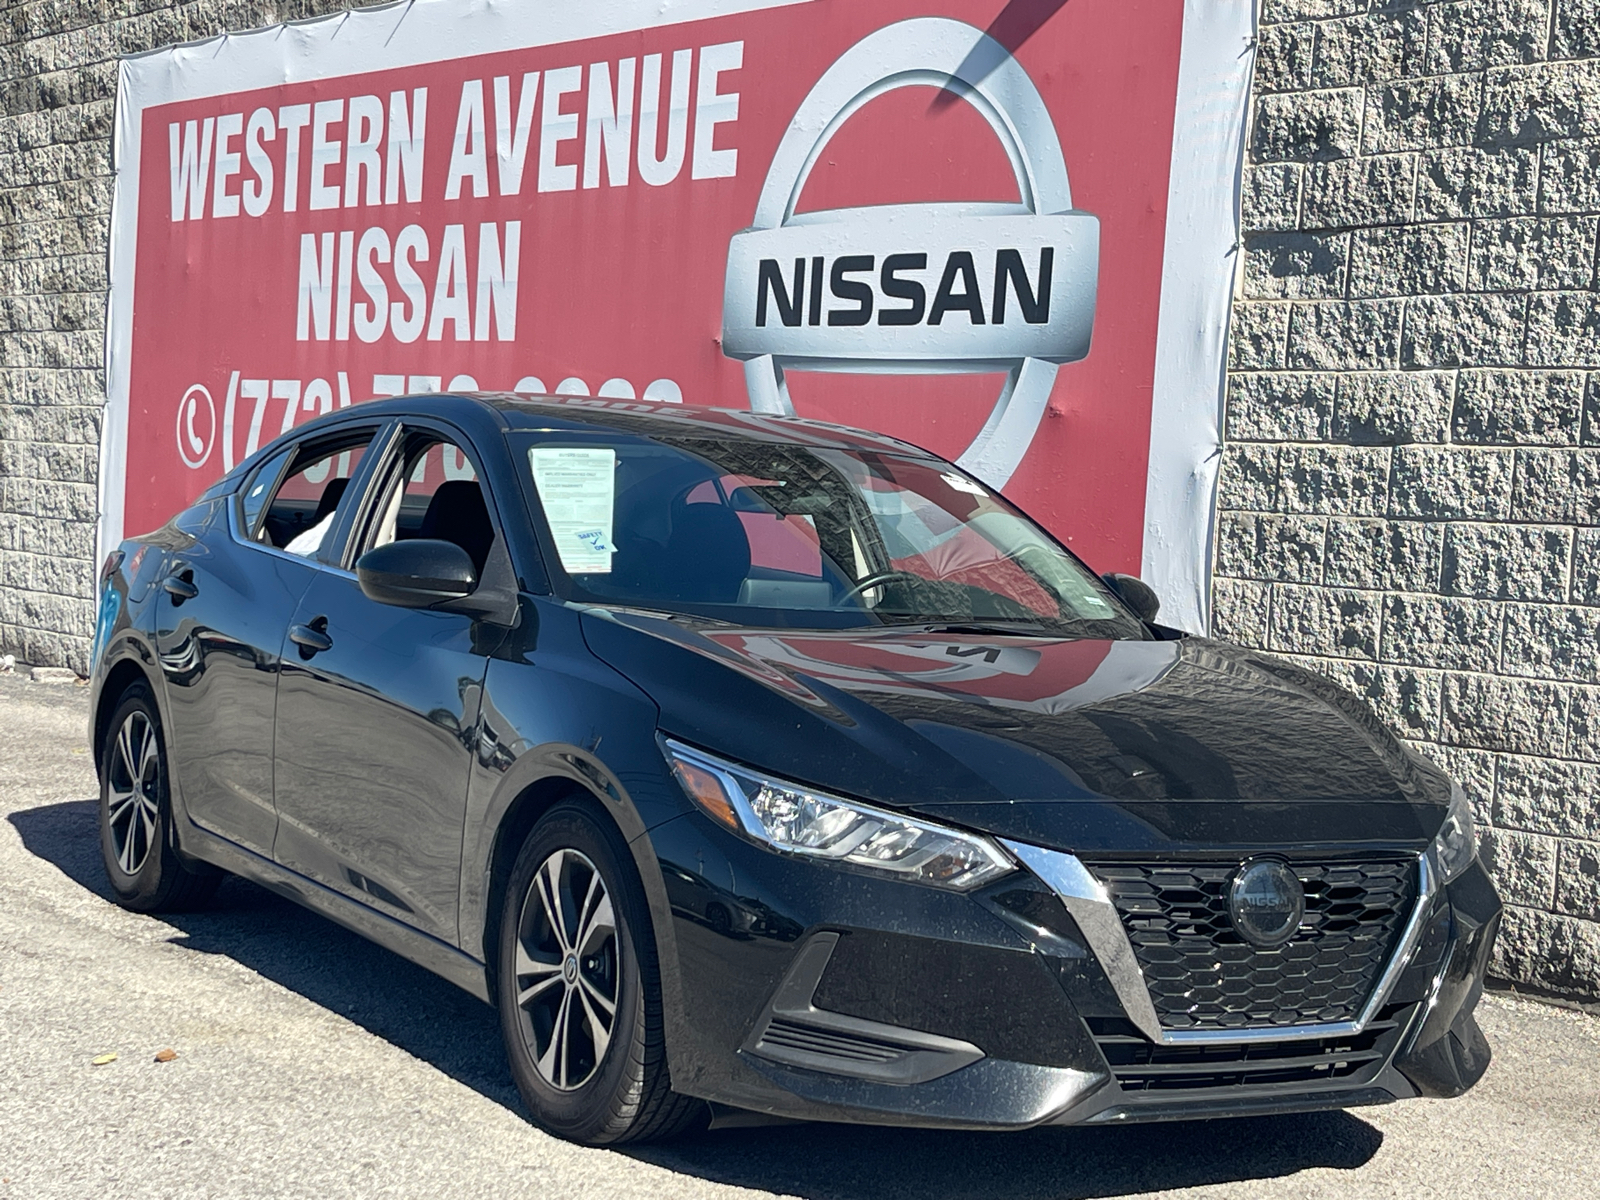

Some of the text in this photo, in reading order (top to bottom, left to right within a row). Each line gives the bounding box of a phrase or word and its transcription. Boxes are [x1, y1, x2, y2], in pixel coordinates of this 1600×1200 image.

[167, 40, 744, 222] WESTERN AVENUE
[296, 220, 522, 344] NISSAN
[755, 246, 1055, 327] NISSAN
